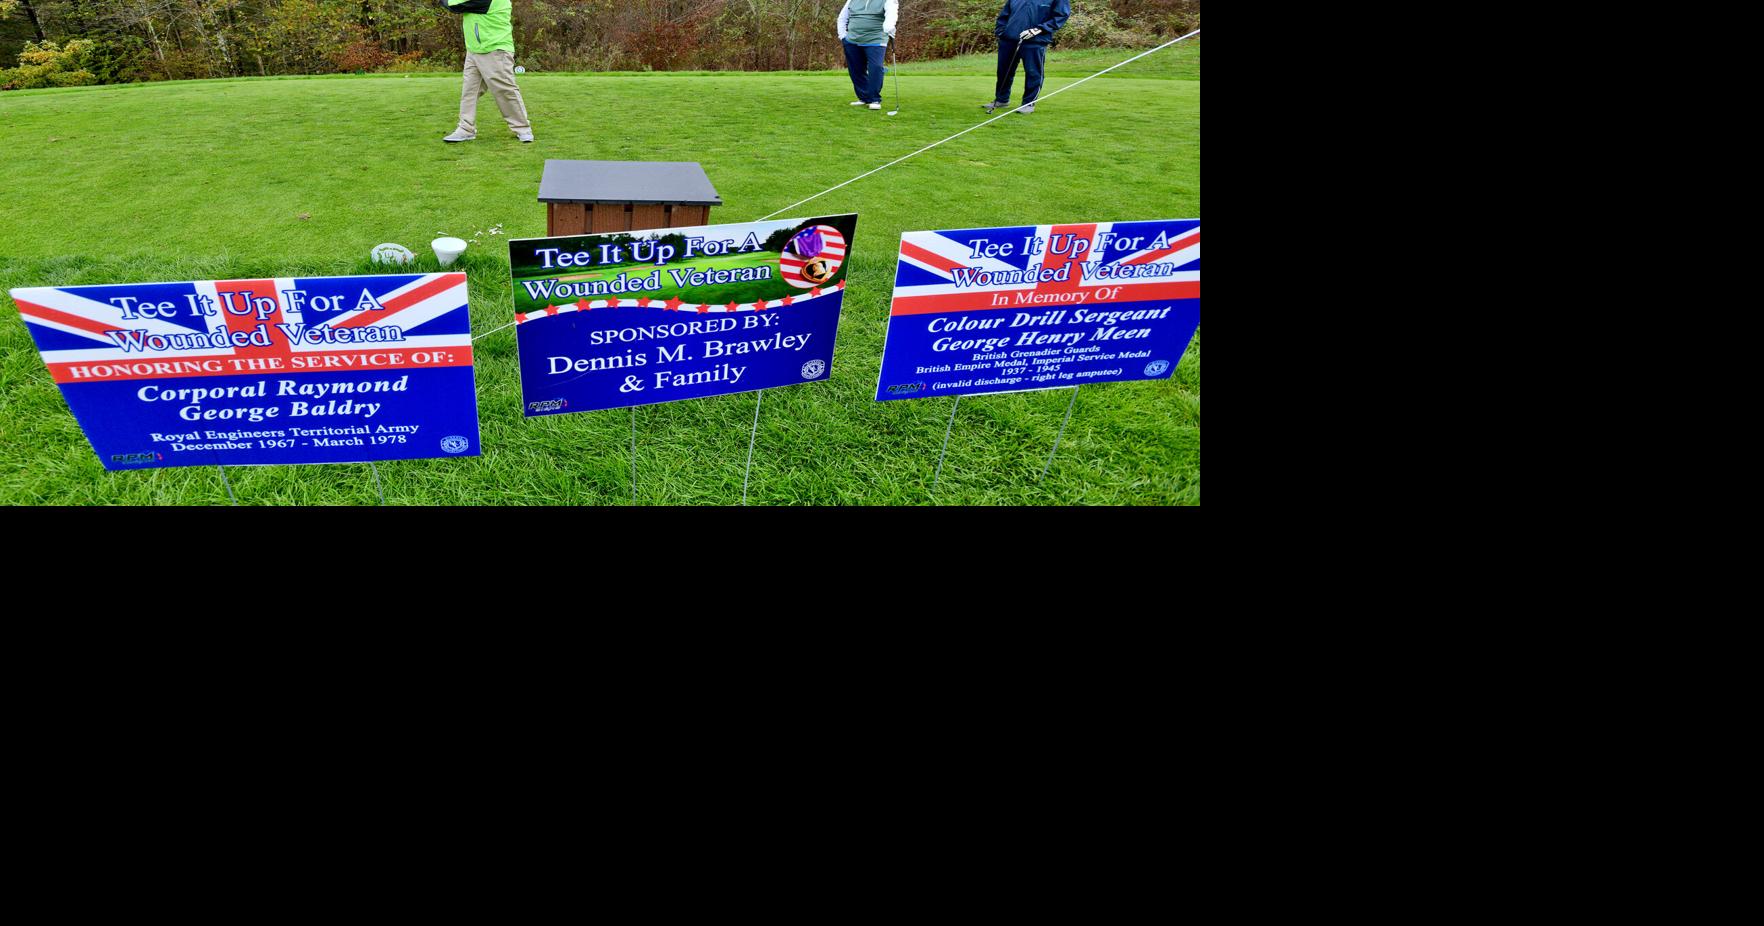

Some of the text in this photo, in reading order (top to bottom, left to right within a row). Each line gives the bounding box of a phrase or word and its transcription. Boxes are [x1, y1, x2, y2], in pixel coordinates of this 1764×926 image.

[535, 231, 764, 270] Tee It Up For A
[969, 230, 1171, 259] Tee It Up For A
[522, 263, 772, 300] Wounded Veteran
[951, 260, 1174, 288] Wounded Veteran
[109, 288, 384, 320] Tee It Up For A
[991, 286, 1123, 306] In Memory Of
[590, 313, 780, 345] SPONSORED BY:
[927, 307, 1172, 333] Colour Drill Sergeant
[105, 323, 405, 353] Wounded Veteran
[932, 328, 1151, 352] George Henry Meen
[69, 351, 455, 378] HONORING THE SERVICE OF:
[547, 332, 812, 375] Dennis M. Brawley
[916, 350, 1151, 374] British Empire Medal, Imperial Service Medal
[972, 345, 1100, 360] British Grenadier Guards
[619, 364, 747, 393] & Family
[932, 380, 972, 390] (invalid
[1031, 372, 1056, 382] right
[1058, 372, 1074, 380] leg
[1076, 368, 1122, 378] amputee)
[1002, 368, 1026, 376] 1937
[1037, 364, 1061, 372] 1945
[137, 375, 409, 404] Corporal Raymond
[887, 383, 920, 392] RPM
[179, 399, 381, 422] George Baldry
[528, 398, 562, 410] RPM
[150, 424, 419, 442] Royal Engineers Territorial Army
[170, 441, 253, 451] December
[259, 439, 295, 448] 1967
[312, 437, 364, 447] March
[370, 435, 407, 444] 1978
[112, 453, 154, 462] RPM
